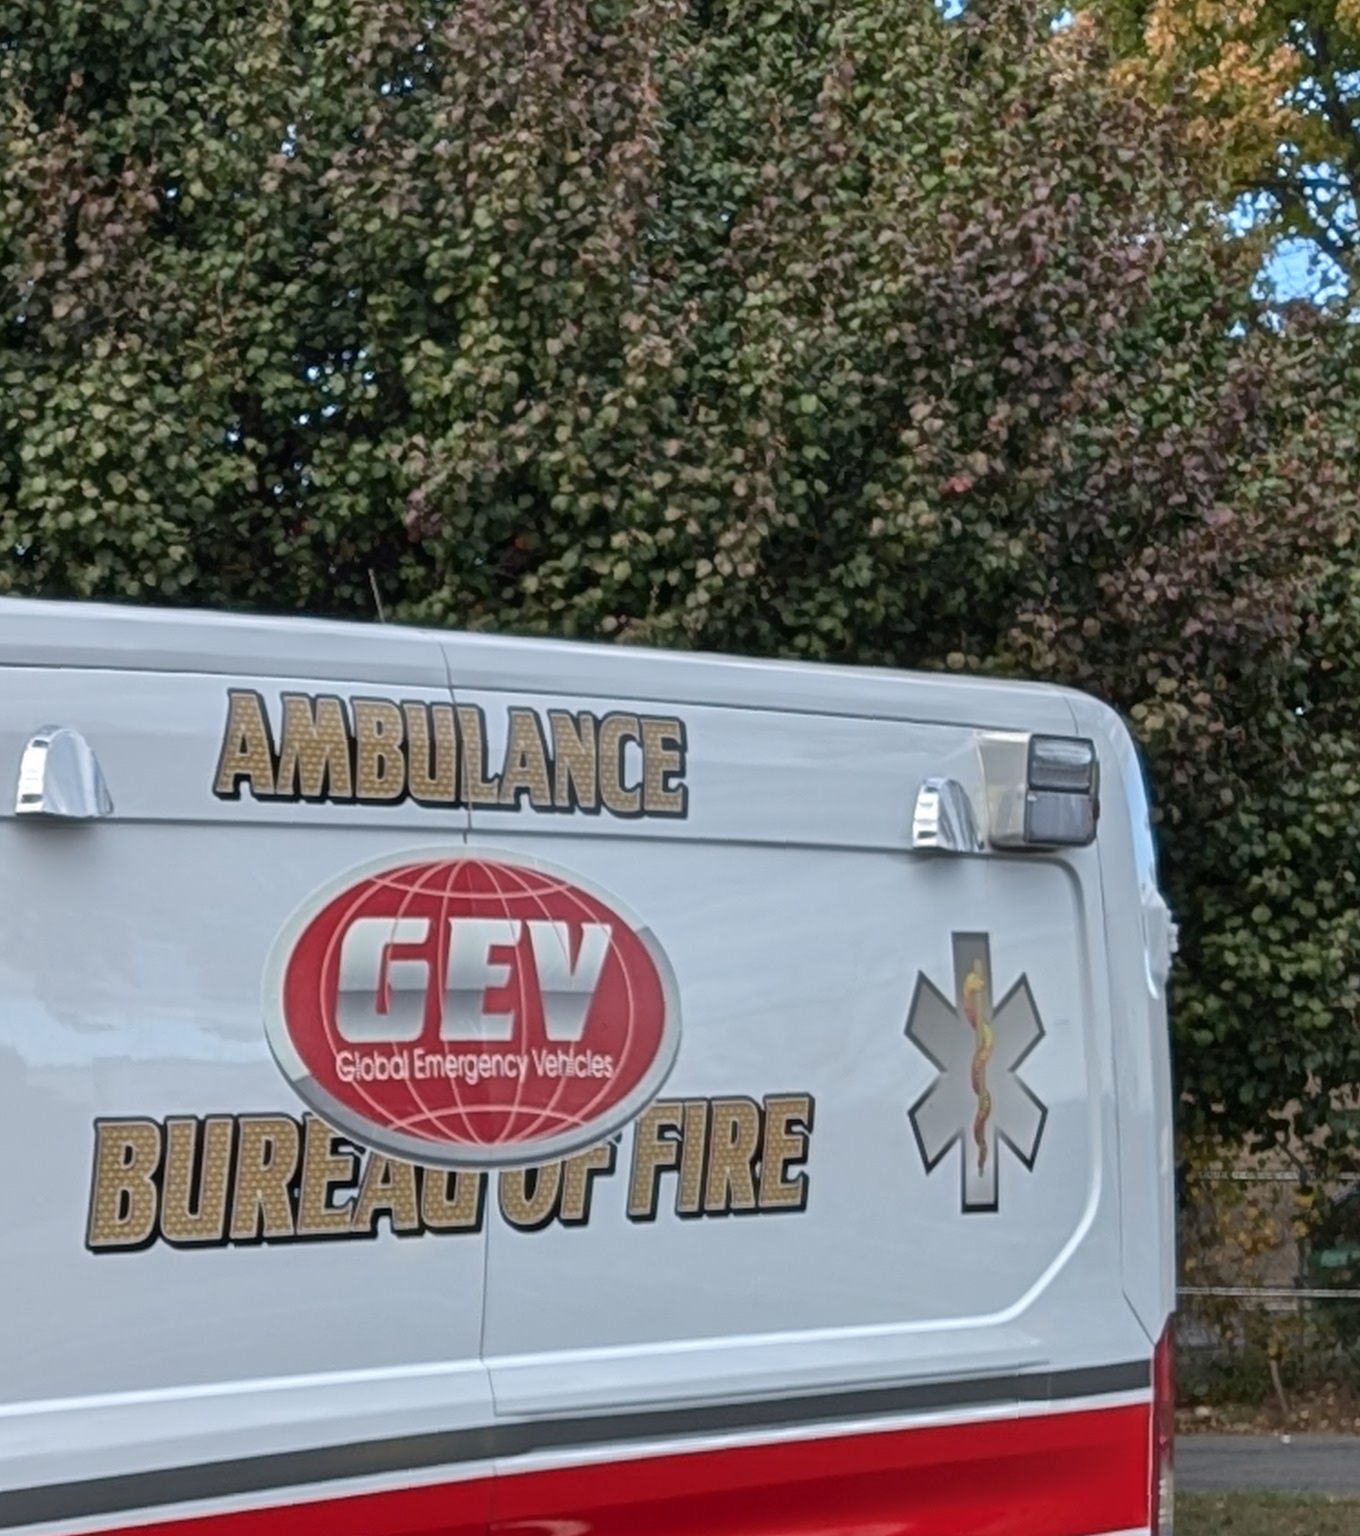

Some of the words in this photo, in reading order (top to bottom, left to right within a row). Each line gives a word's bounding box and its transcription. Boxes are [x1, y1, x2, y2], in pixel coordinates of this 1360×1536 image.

[213, 688, 688, 819] AMBULANCE
[335, 917, 612, 1043] GEV
[336, 1049, 409, 1082] Global
[414, 1048, 529, 1085] Emergency
[532, 1048, 614, 1080] Vehicles
[626, 1094, 815, 1222] FIRE
